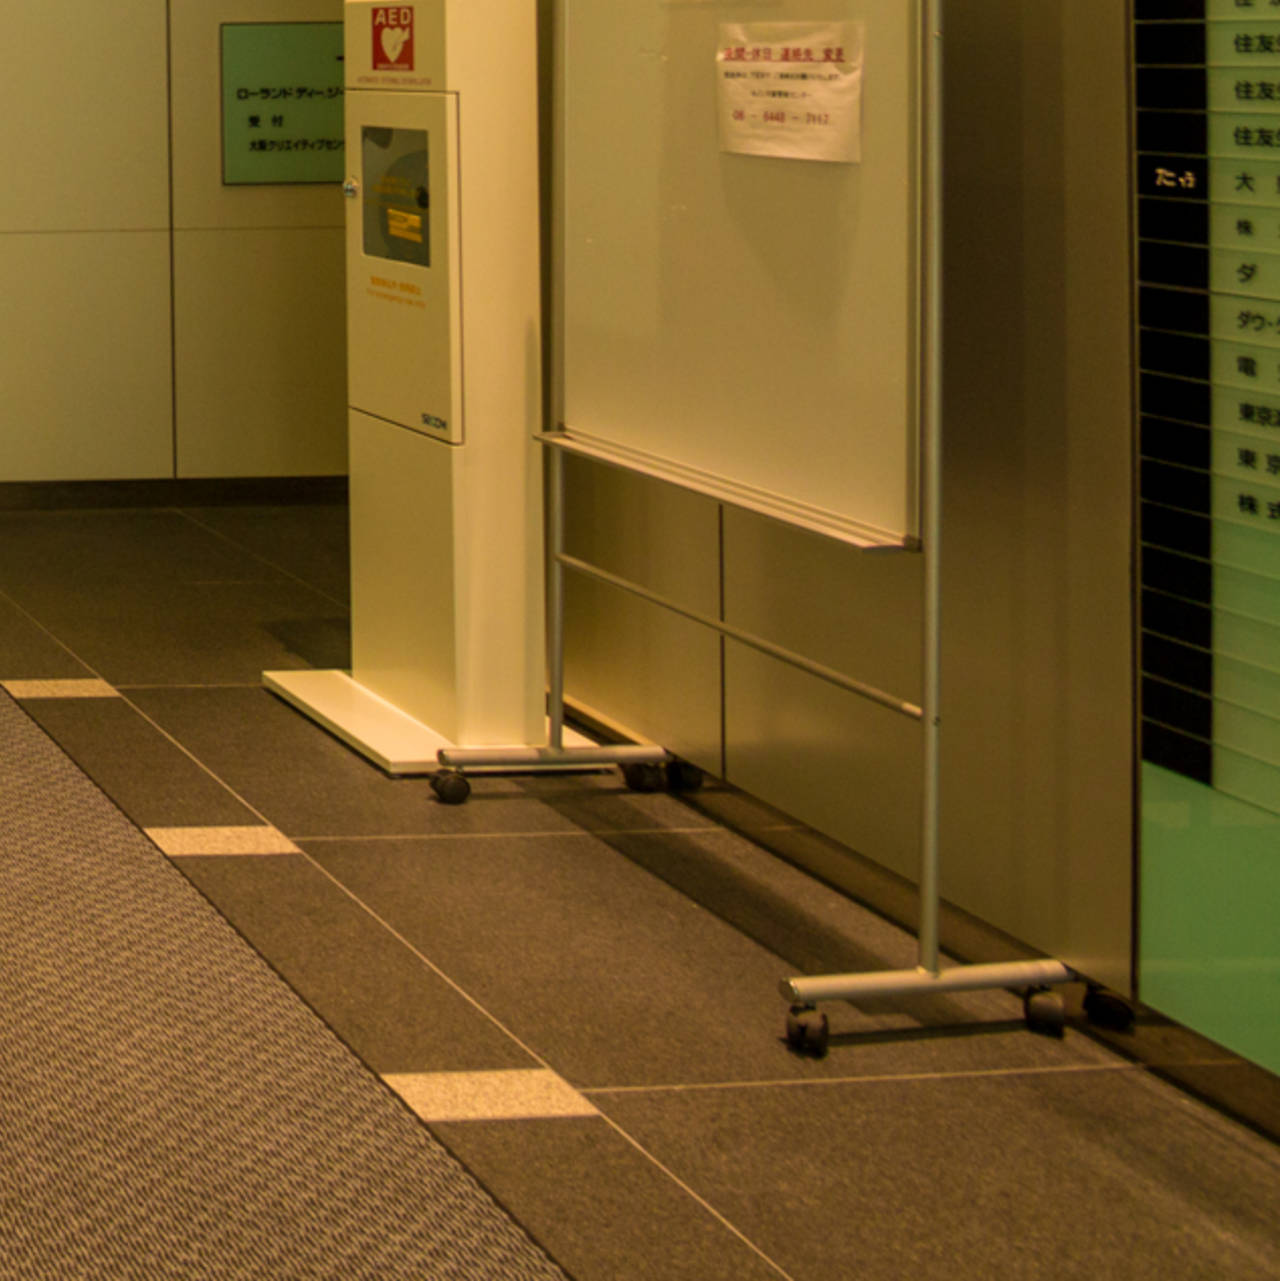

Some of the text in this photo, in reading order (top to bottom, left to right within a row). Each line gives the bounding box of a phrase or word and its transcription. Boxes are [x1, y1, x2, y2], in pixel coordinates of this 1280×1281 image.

[375, 8, 411, 25] AED
[1234, 33, 1280, 53] 住友
[1234, 80, 1280, 101] 住友
[1234, 126, 1280, 148] 住友
